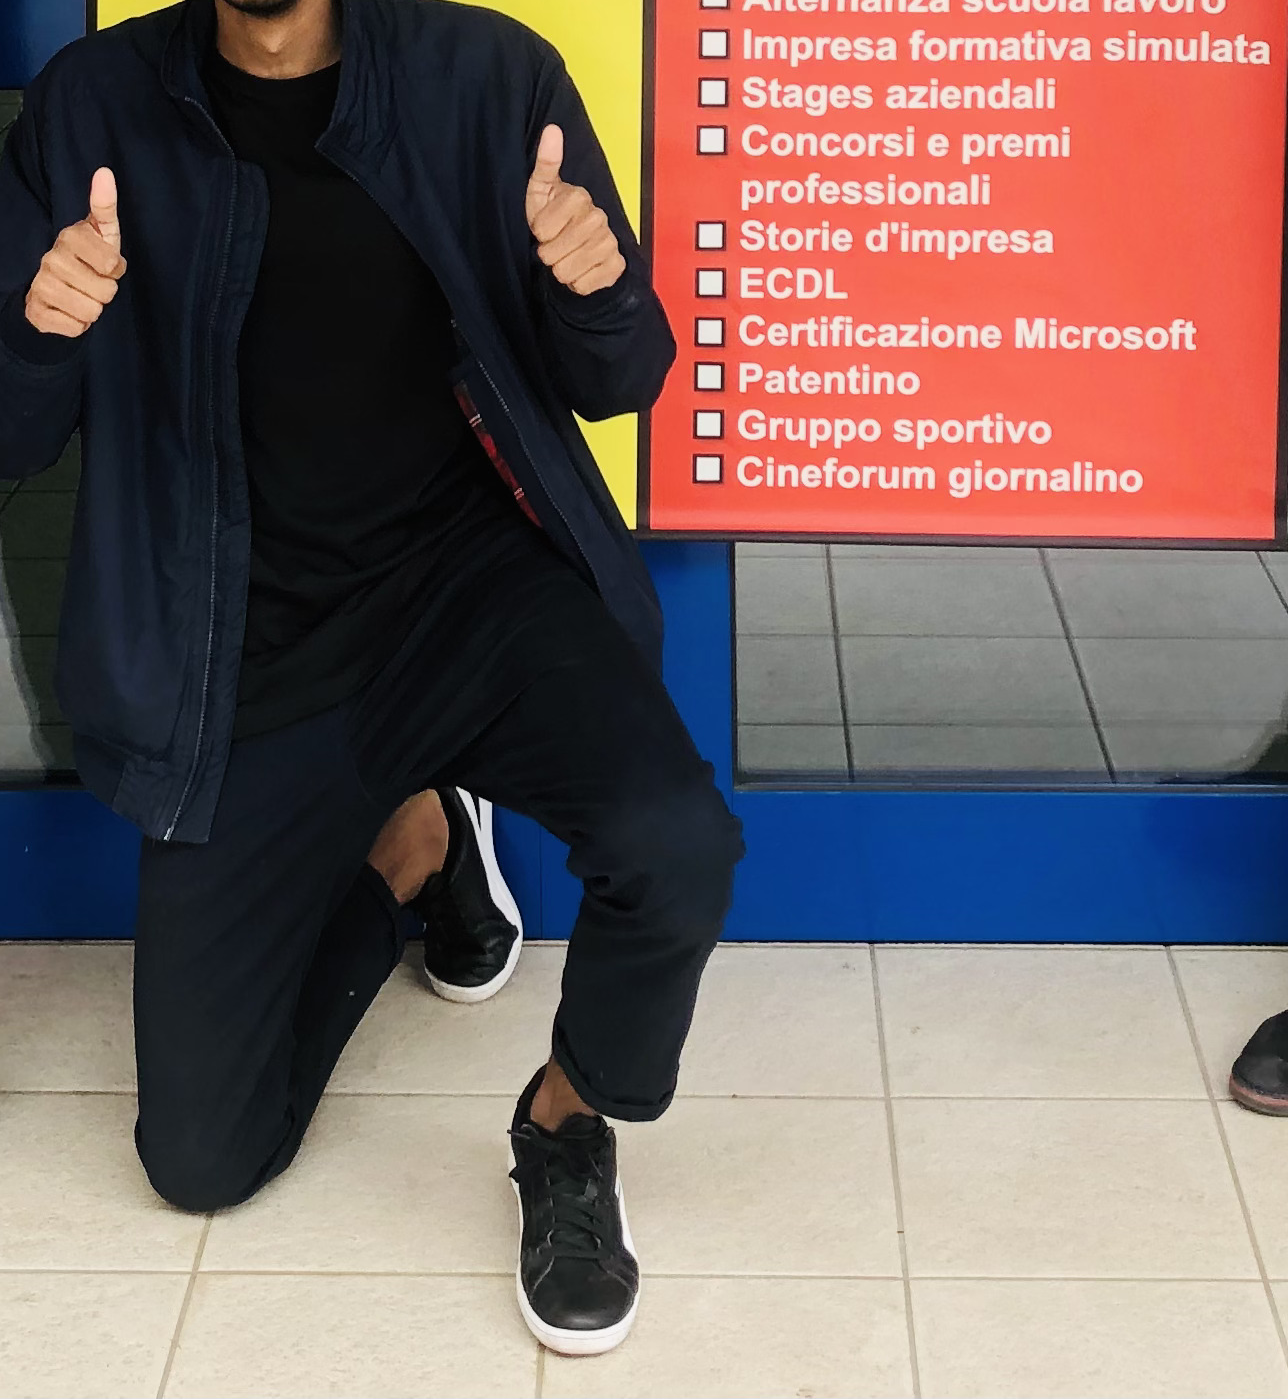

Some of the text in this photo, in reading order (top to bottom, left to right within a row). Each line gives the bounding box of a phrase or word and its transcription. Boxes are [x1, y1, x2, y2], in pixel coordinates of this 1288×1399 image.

[743, 28, 1271, 68] Impresa formativa simulata
[741, 75, 1056, 117] Stages aziendali
[741, 123, 1071, 165] Concorsi e premi
[741, 172, 991, 211] professionali
[739, 219, 1054, 261] Storie d'impresa
[740, 267, 849, 300] ECDL
[738, 314, 1197, 351] Certificazione Microsoft
[738, 362, 921, 396] Patentino
[737, 409, 1053, 451] Gruppo sportivo
[736, 455, 1144, 499] Cineforum giornalino
